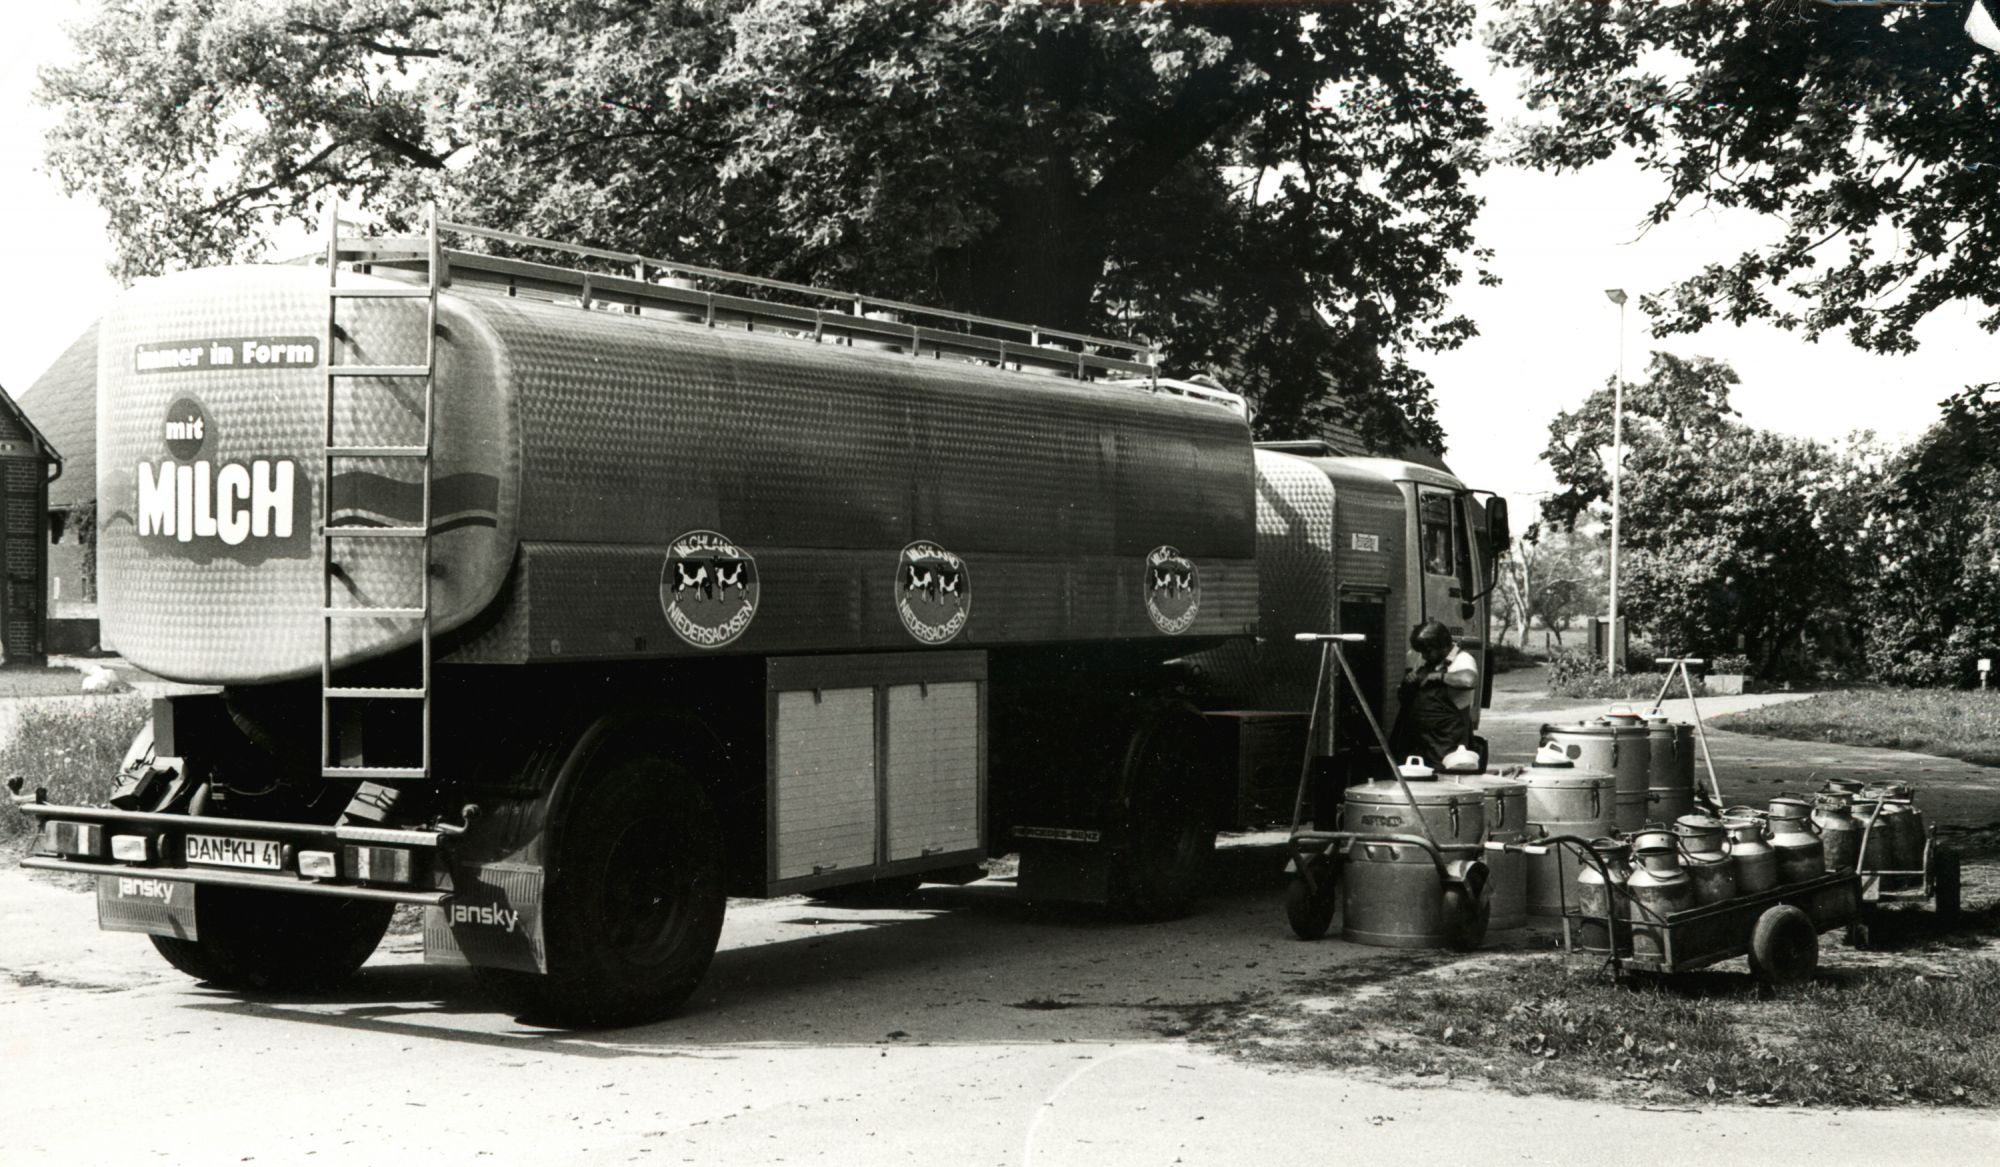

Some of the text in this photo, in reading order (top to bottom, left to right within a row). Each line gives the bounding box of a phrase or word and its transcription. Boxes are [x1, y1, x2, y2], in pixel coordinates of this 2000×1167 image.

[137, 341, 314, 370] immer in Form
[166, 415, 203, 440] mit
[138, 460, 295, 545] MILCH
[667, 600, 753, 644] NIEDERSACHSEN
[900, 598, 965, 641] NIEDERSACHSEN
[262, 843, 279, 866] 41
[118, 876, 174, 905] jansky
[449, 902, 518, 932] jansky
